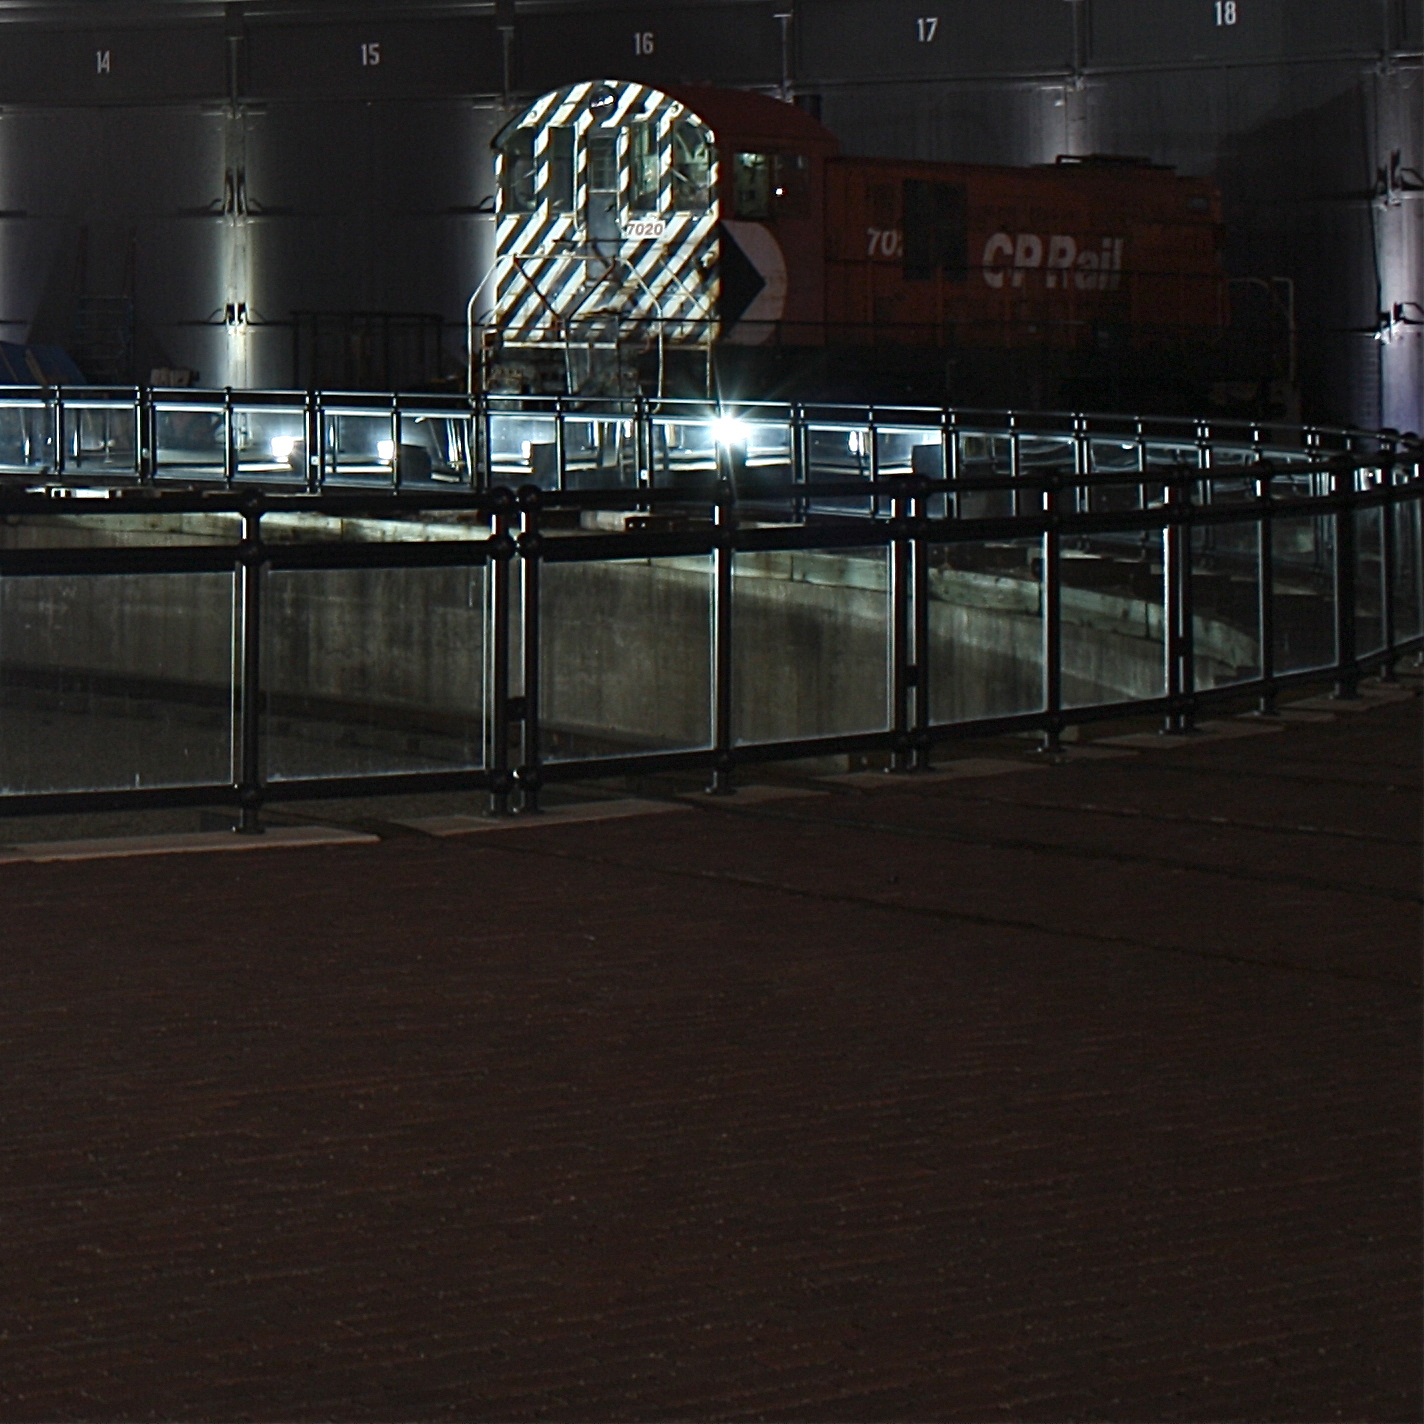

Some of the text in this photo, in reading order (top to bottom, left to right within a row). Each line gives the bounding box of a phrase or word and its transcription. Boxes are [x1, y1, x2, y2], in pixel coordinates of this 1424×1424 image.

[1214, 0, 1237, 26] 18
[916, 17, 939, 43] 17
[360, 42, 381, 67] 15
[633, 31, 654, 56] 16
[95, 50, 112, 74] 14
[627, 222, 663, 236] 7020
[982, 232, 1125, 290] CP Rail
